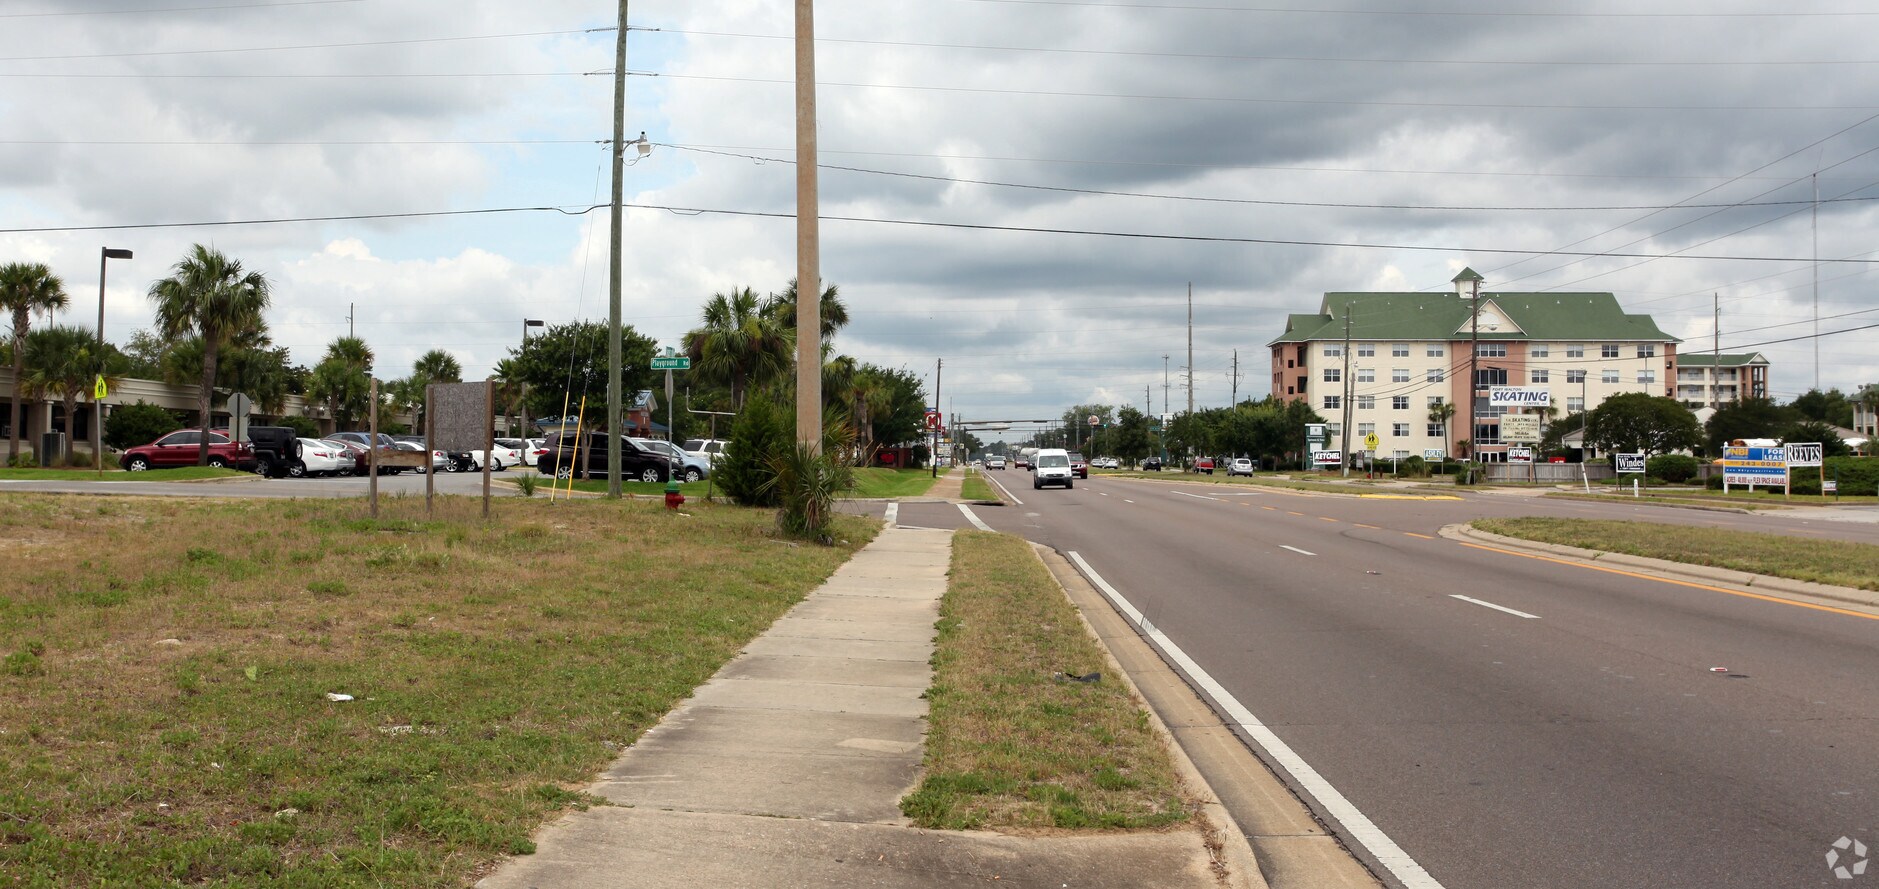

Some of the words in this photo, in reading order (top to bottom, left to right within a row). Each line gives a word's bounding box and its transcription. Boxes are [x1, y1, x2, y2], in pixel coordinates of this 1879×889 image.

[652, 359, 678, 368] Playground
[1492, 391, 1547, 401] SKATING
[1314, 452, 1341, 460] KETCHEL
[1509, 449, 1530, 457] KETCHEL
[1731, 448, 1749, 456] NBI
[1787, 445, 1820, 462] REEVES
[1618, 457, 1644, 468] Windes
